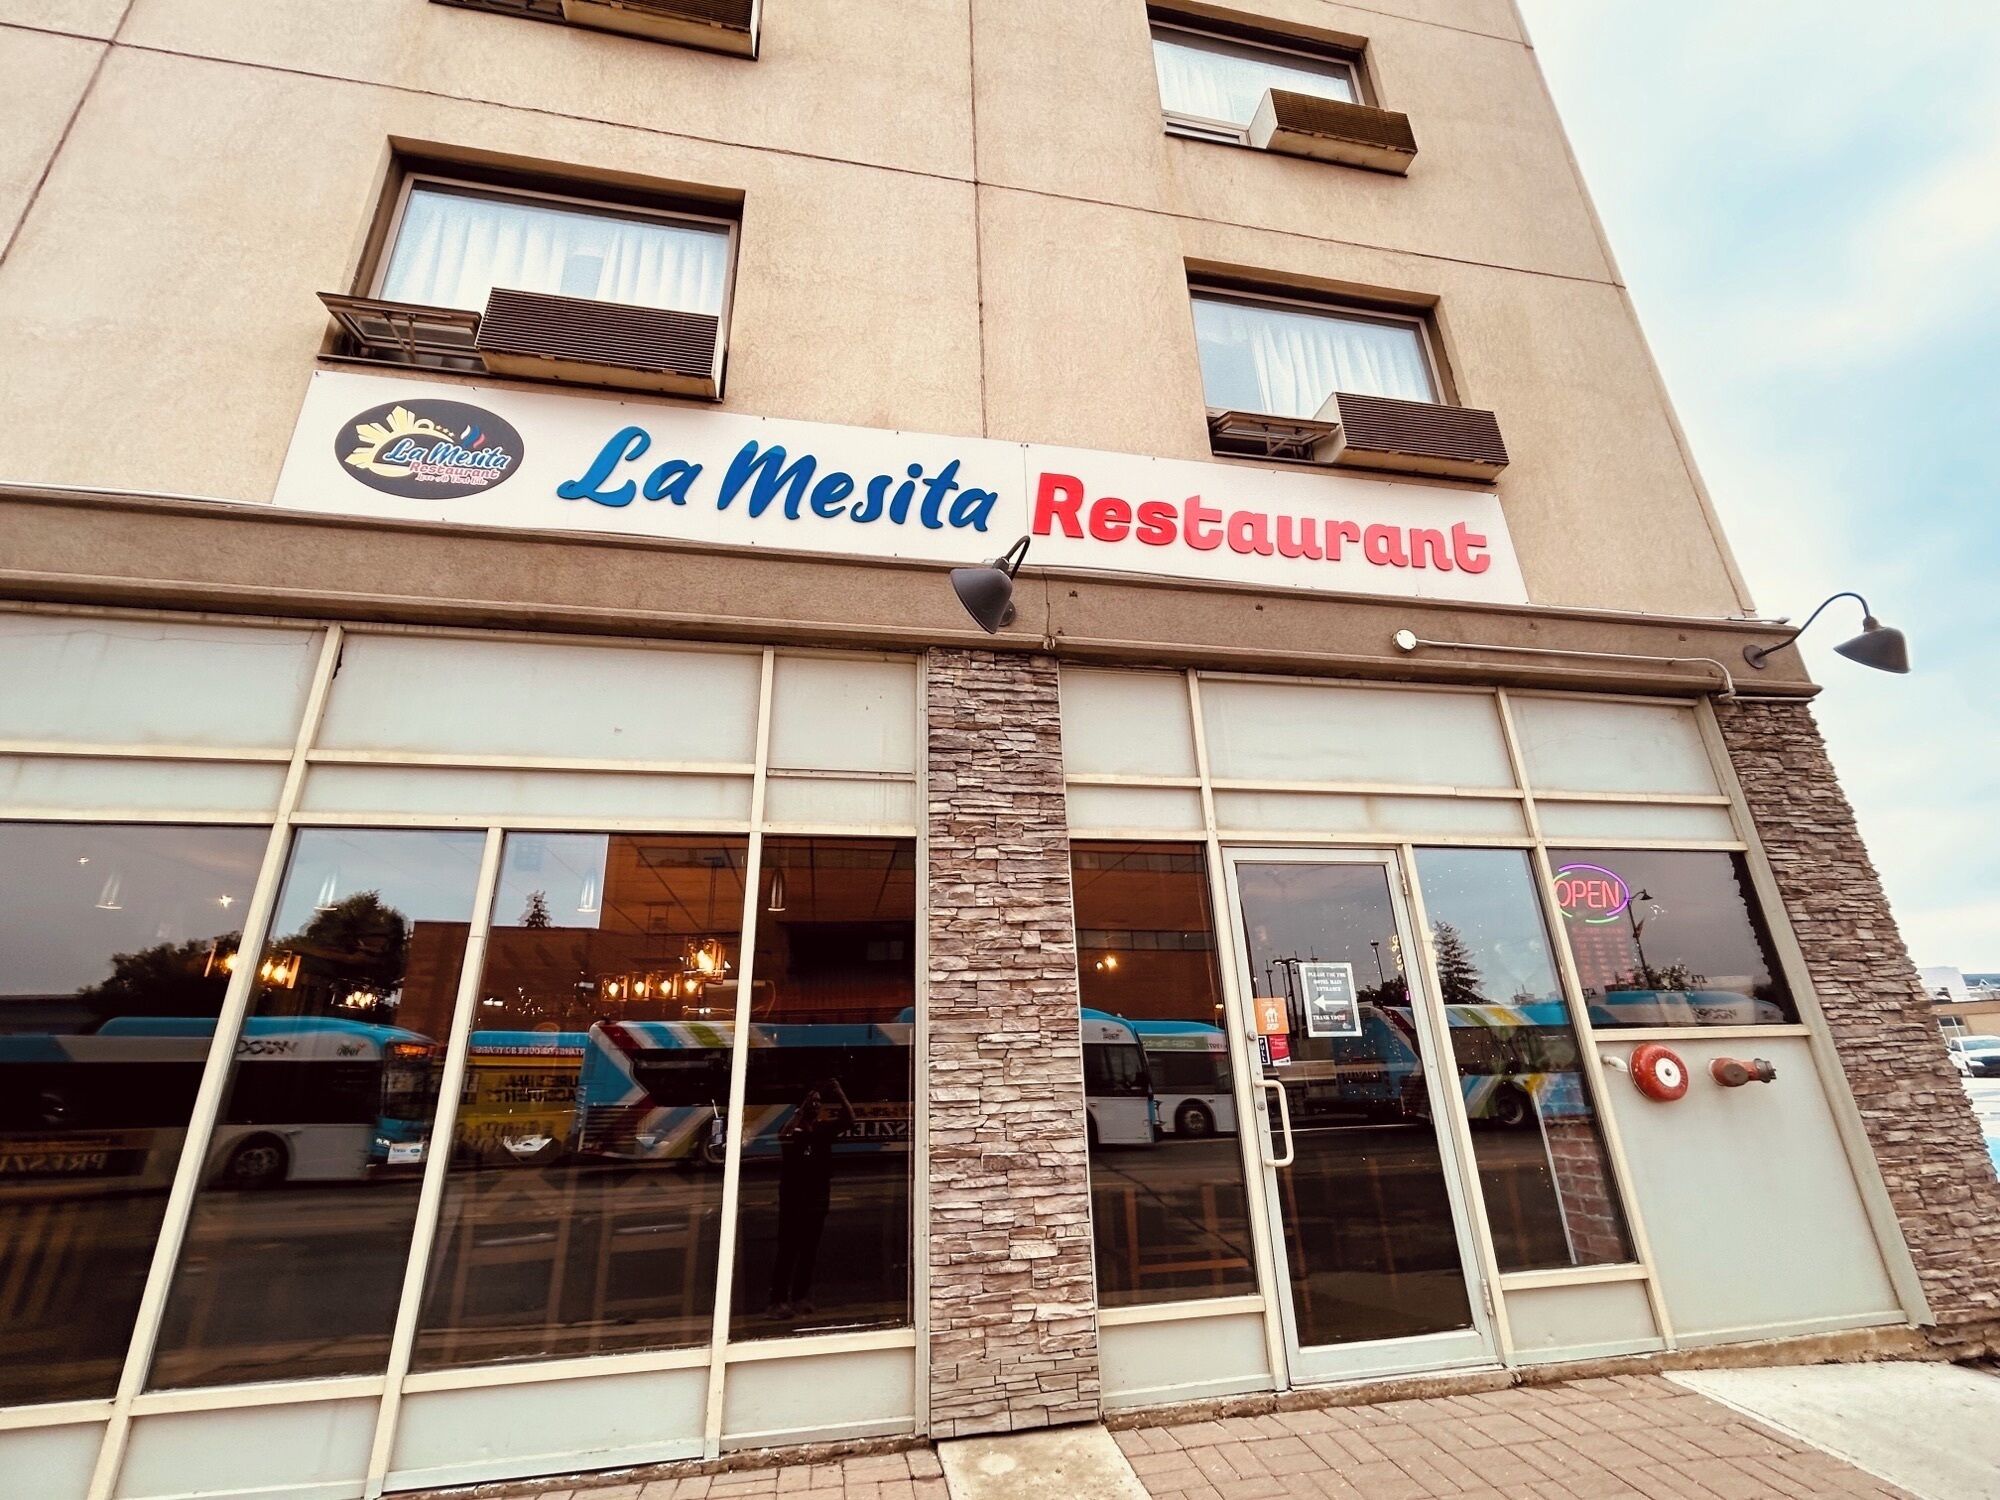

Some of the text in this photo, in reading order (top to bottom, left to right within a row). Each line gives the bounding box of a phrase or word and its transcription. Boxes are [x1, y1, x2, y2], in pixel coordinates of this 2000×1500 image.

[383, 437, 511, 470] La Mesita
[409, 461, 501, 480] Restaurant
[556, 424, 998, 532] La Mesita
[1032, 472, 1491, 574] Restaurant
[1553, 880, 1620, 908] OPEN
